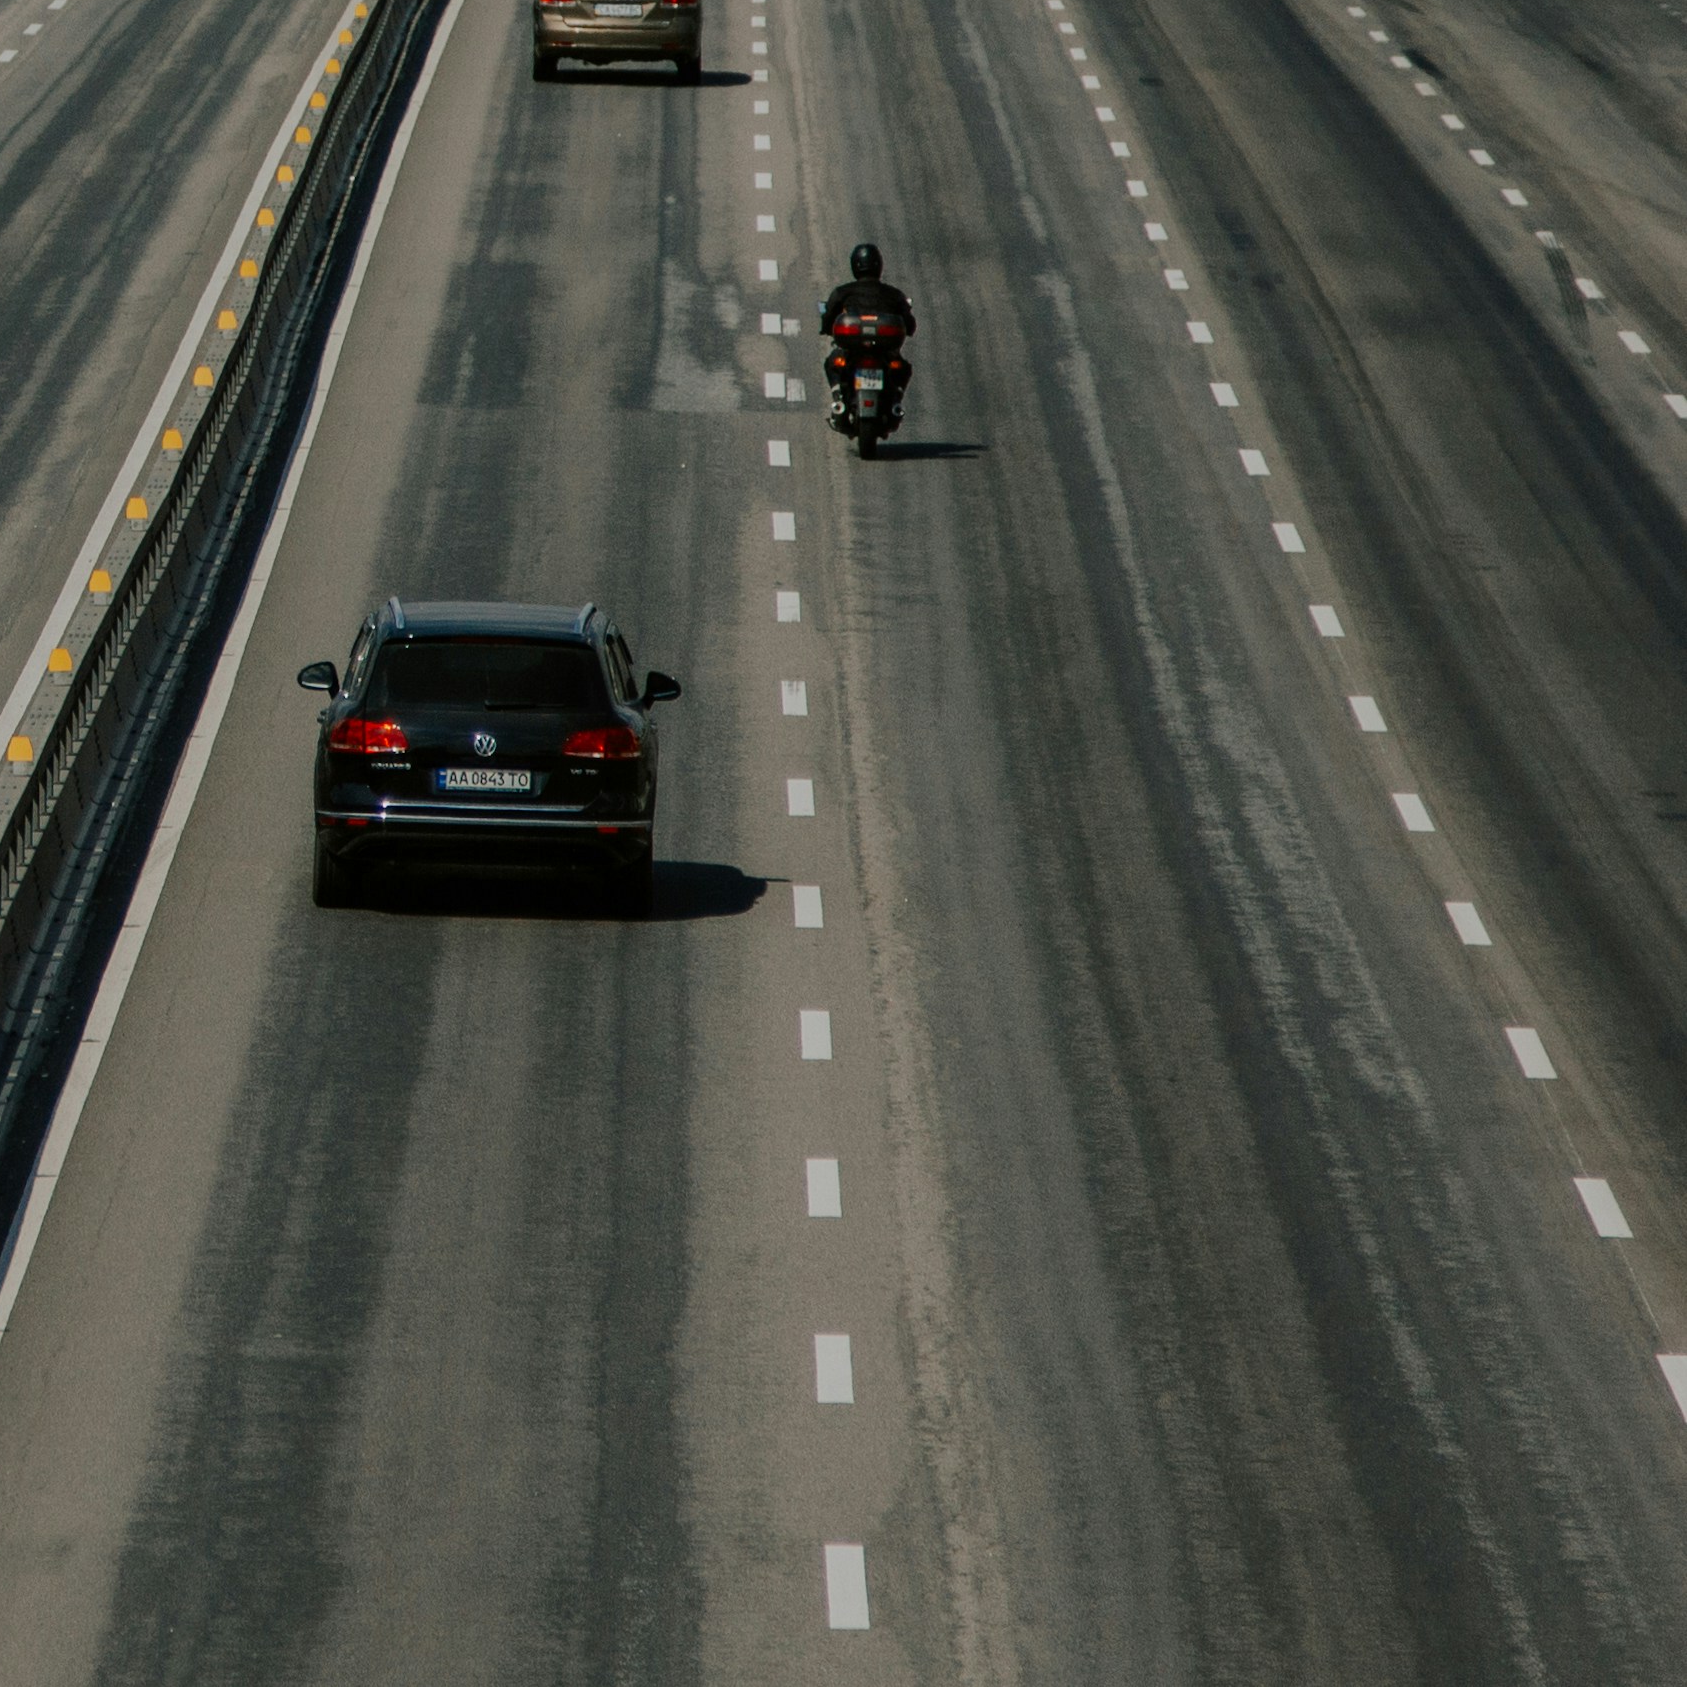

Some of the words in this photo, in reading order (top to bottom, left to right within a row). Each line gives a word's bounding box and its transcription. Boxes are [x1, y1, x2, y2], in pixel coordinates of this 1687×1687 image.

[448, 771, 469, 785] AA
[471, 772, 505, 786] 0843
[507, 773, 528, 787] TO
